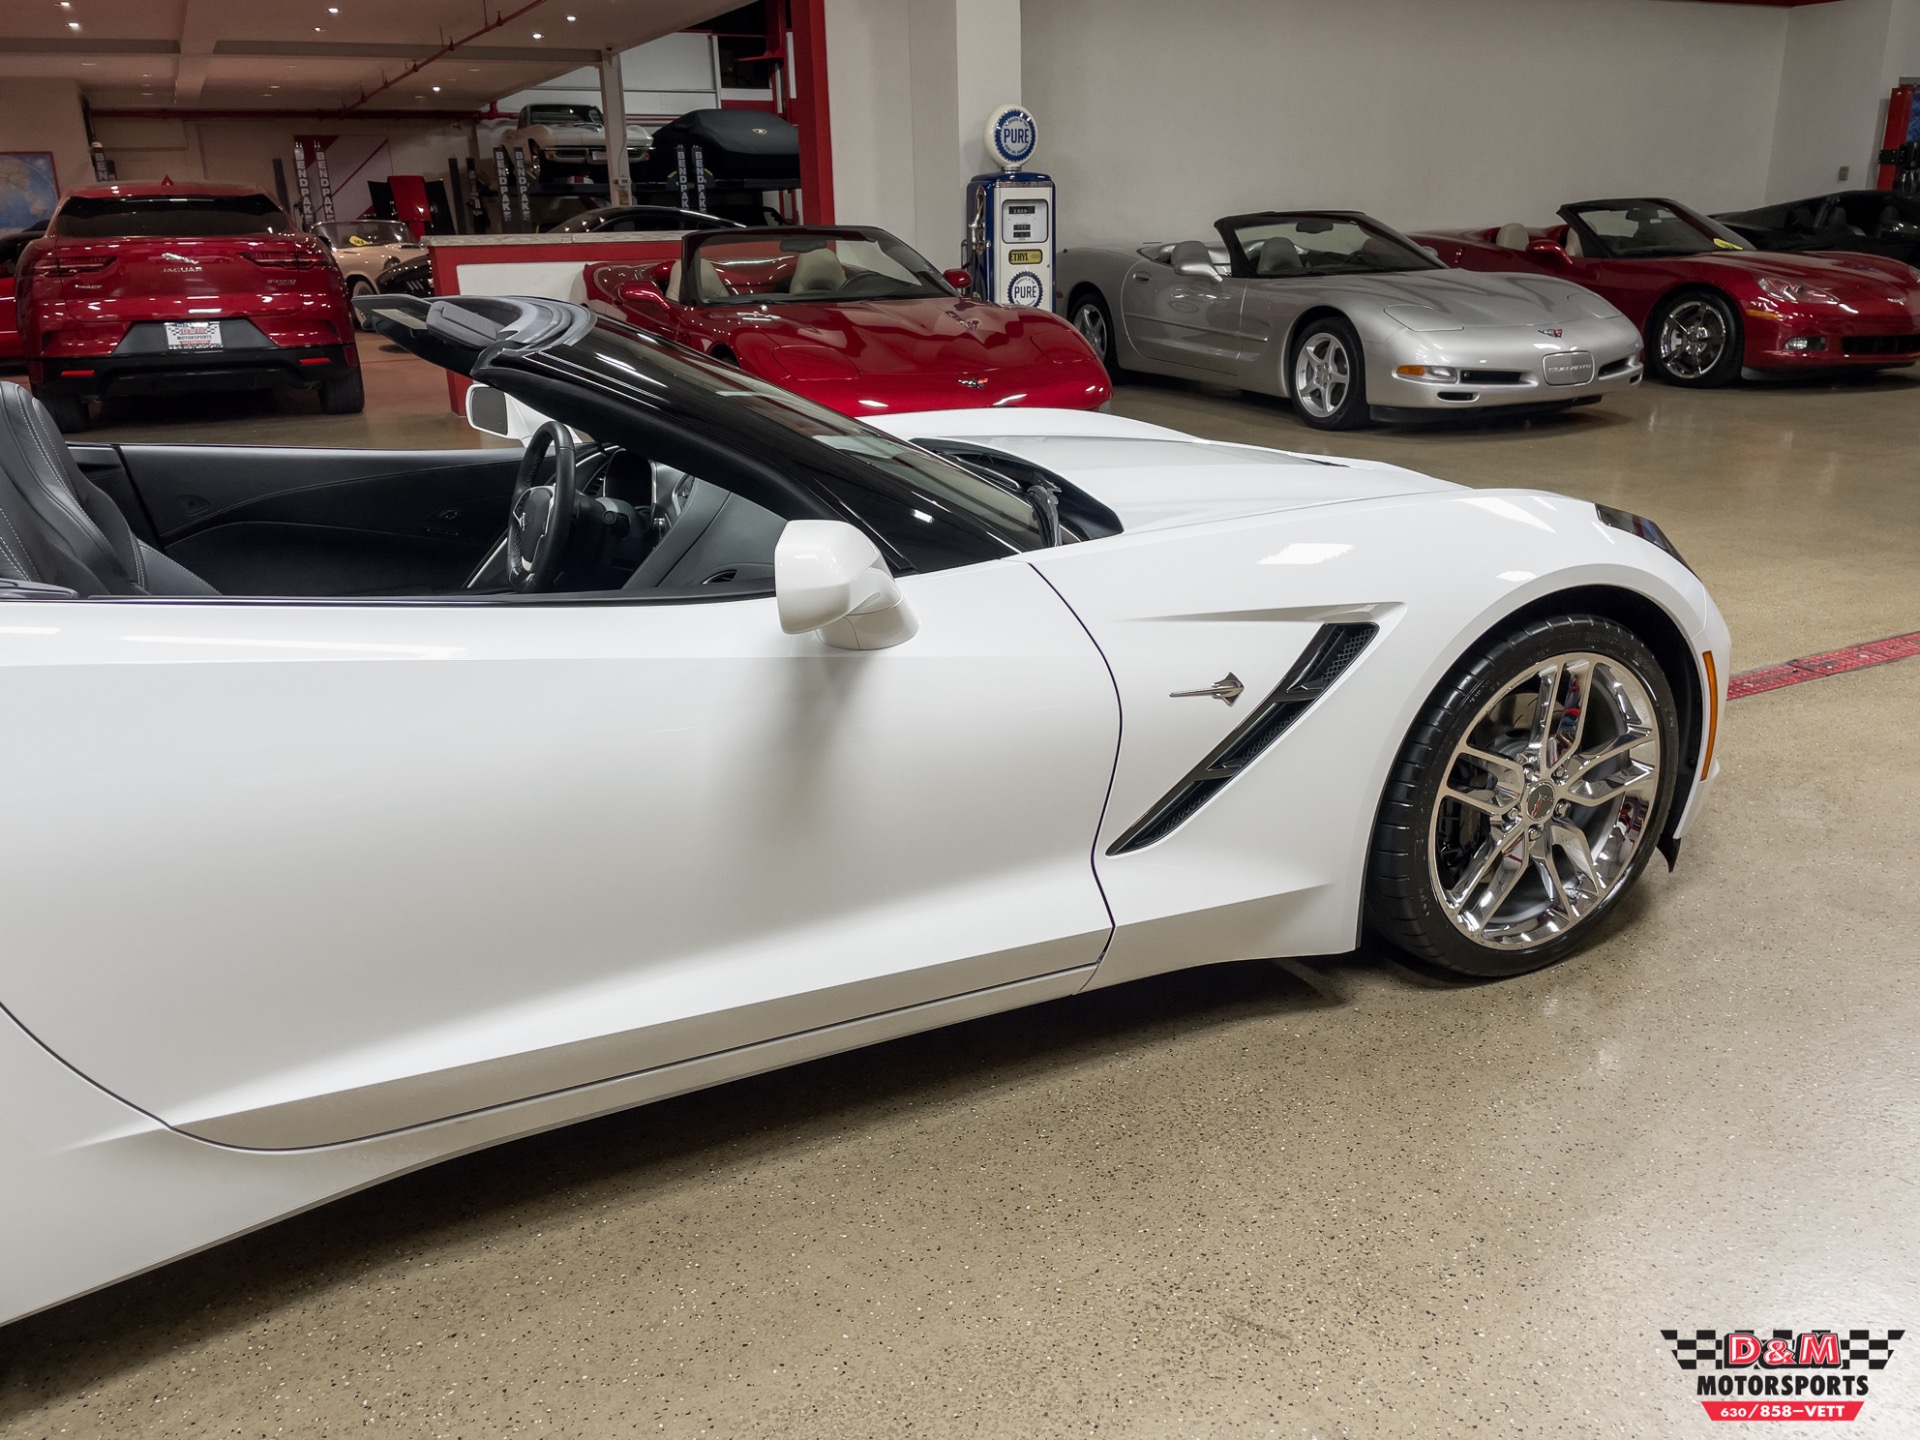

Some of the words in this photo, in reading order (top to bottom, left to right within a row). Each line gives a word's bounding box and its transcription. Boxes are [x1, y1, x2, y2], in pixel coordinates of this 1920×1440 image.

[1003, 128, 1030, 144] PURE
[295, 151, 312, 213] BENDPAK
[316, 152, 334, 213] BENDPAK
[496, 151, 511, 211] BENDPAK
[515, 151, 530, 211] BENDPAK
[677, 151, 689, 208] BENDPAK
[695, 151, 707, 208] BENDPAK
[1010, 253, 1029, 262] ETHYL
[1014, 285, 1037, 299] PURE
